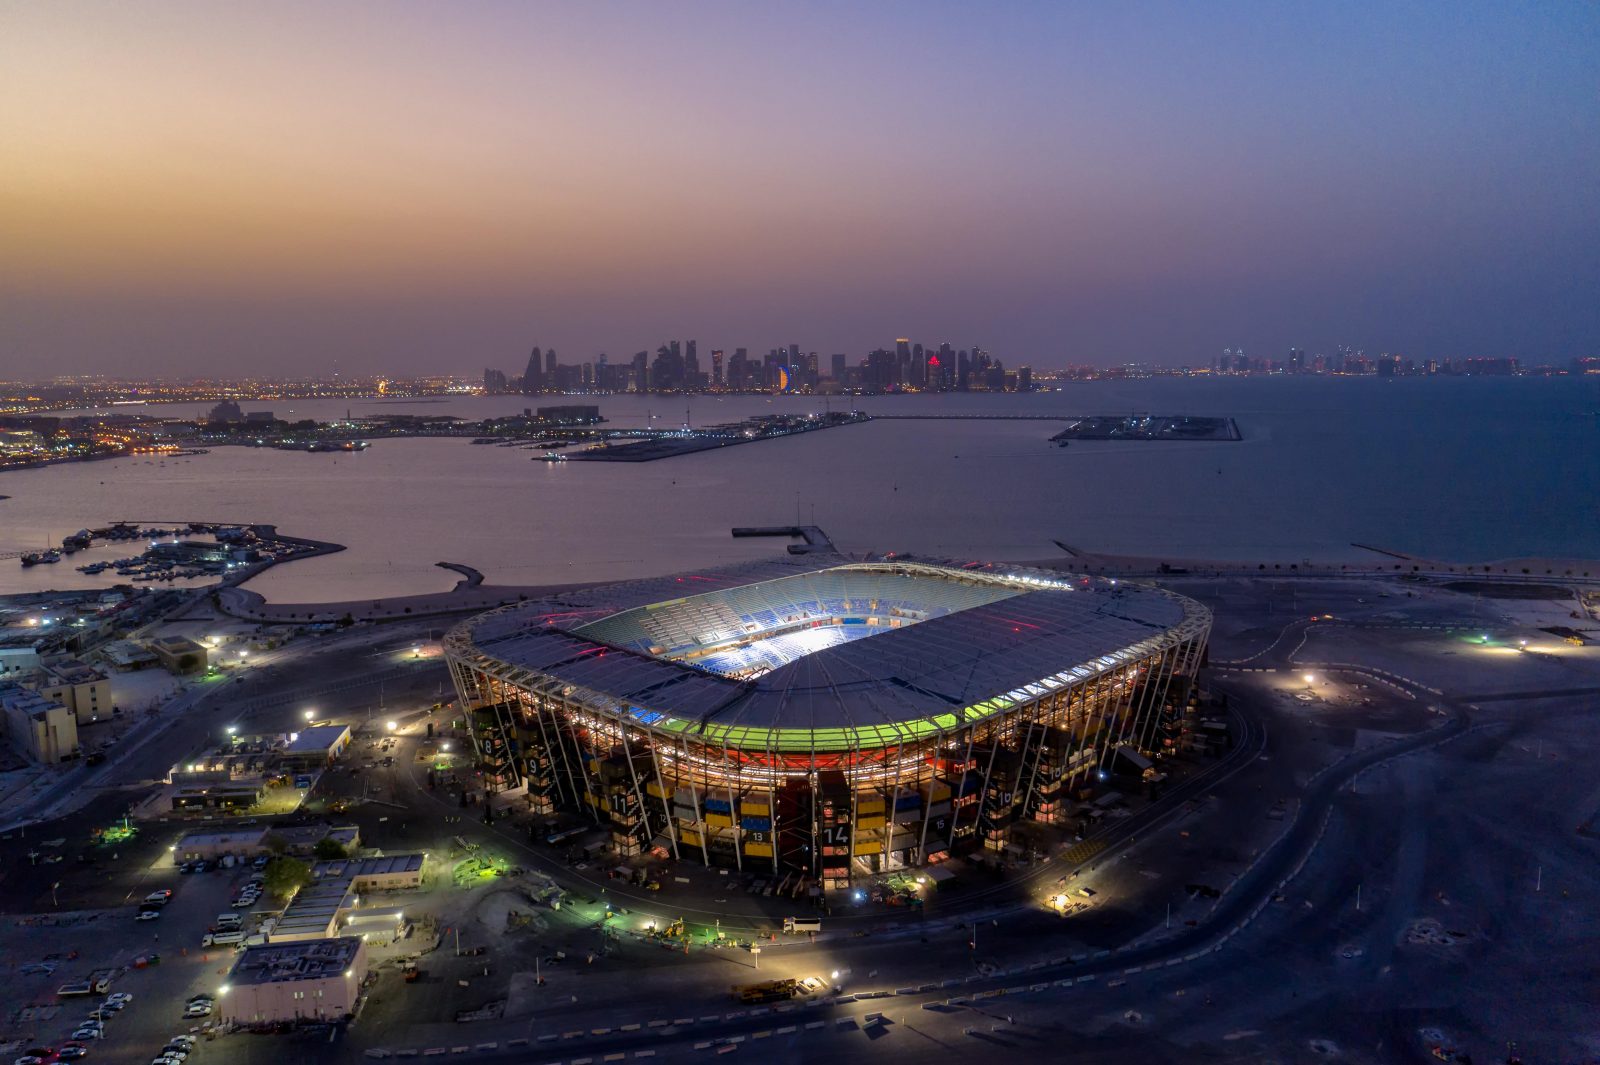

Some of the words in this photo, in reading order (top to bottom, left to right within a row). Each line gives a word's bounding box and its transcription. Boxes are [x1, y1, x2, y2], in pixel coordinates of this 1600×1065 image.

[485, 739, 492, 754] 8
[529, 759, 537, 774] 9
[612, 794, 626, 814] 11
[936, 819, 945, 829] 15
[753, 832, 763, 842] 13
[824, 826, 848, 844] 14
